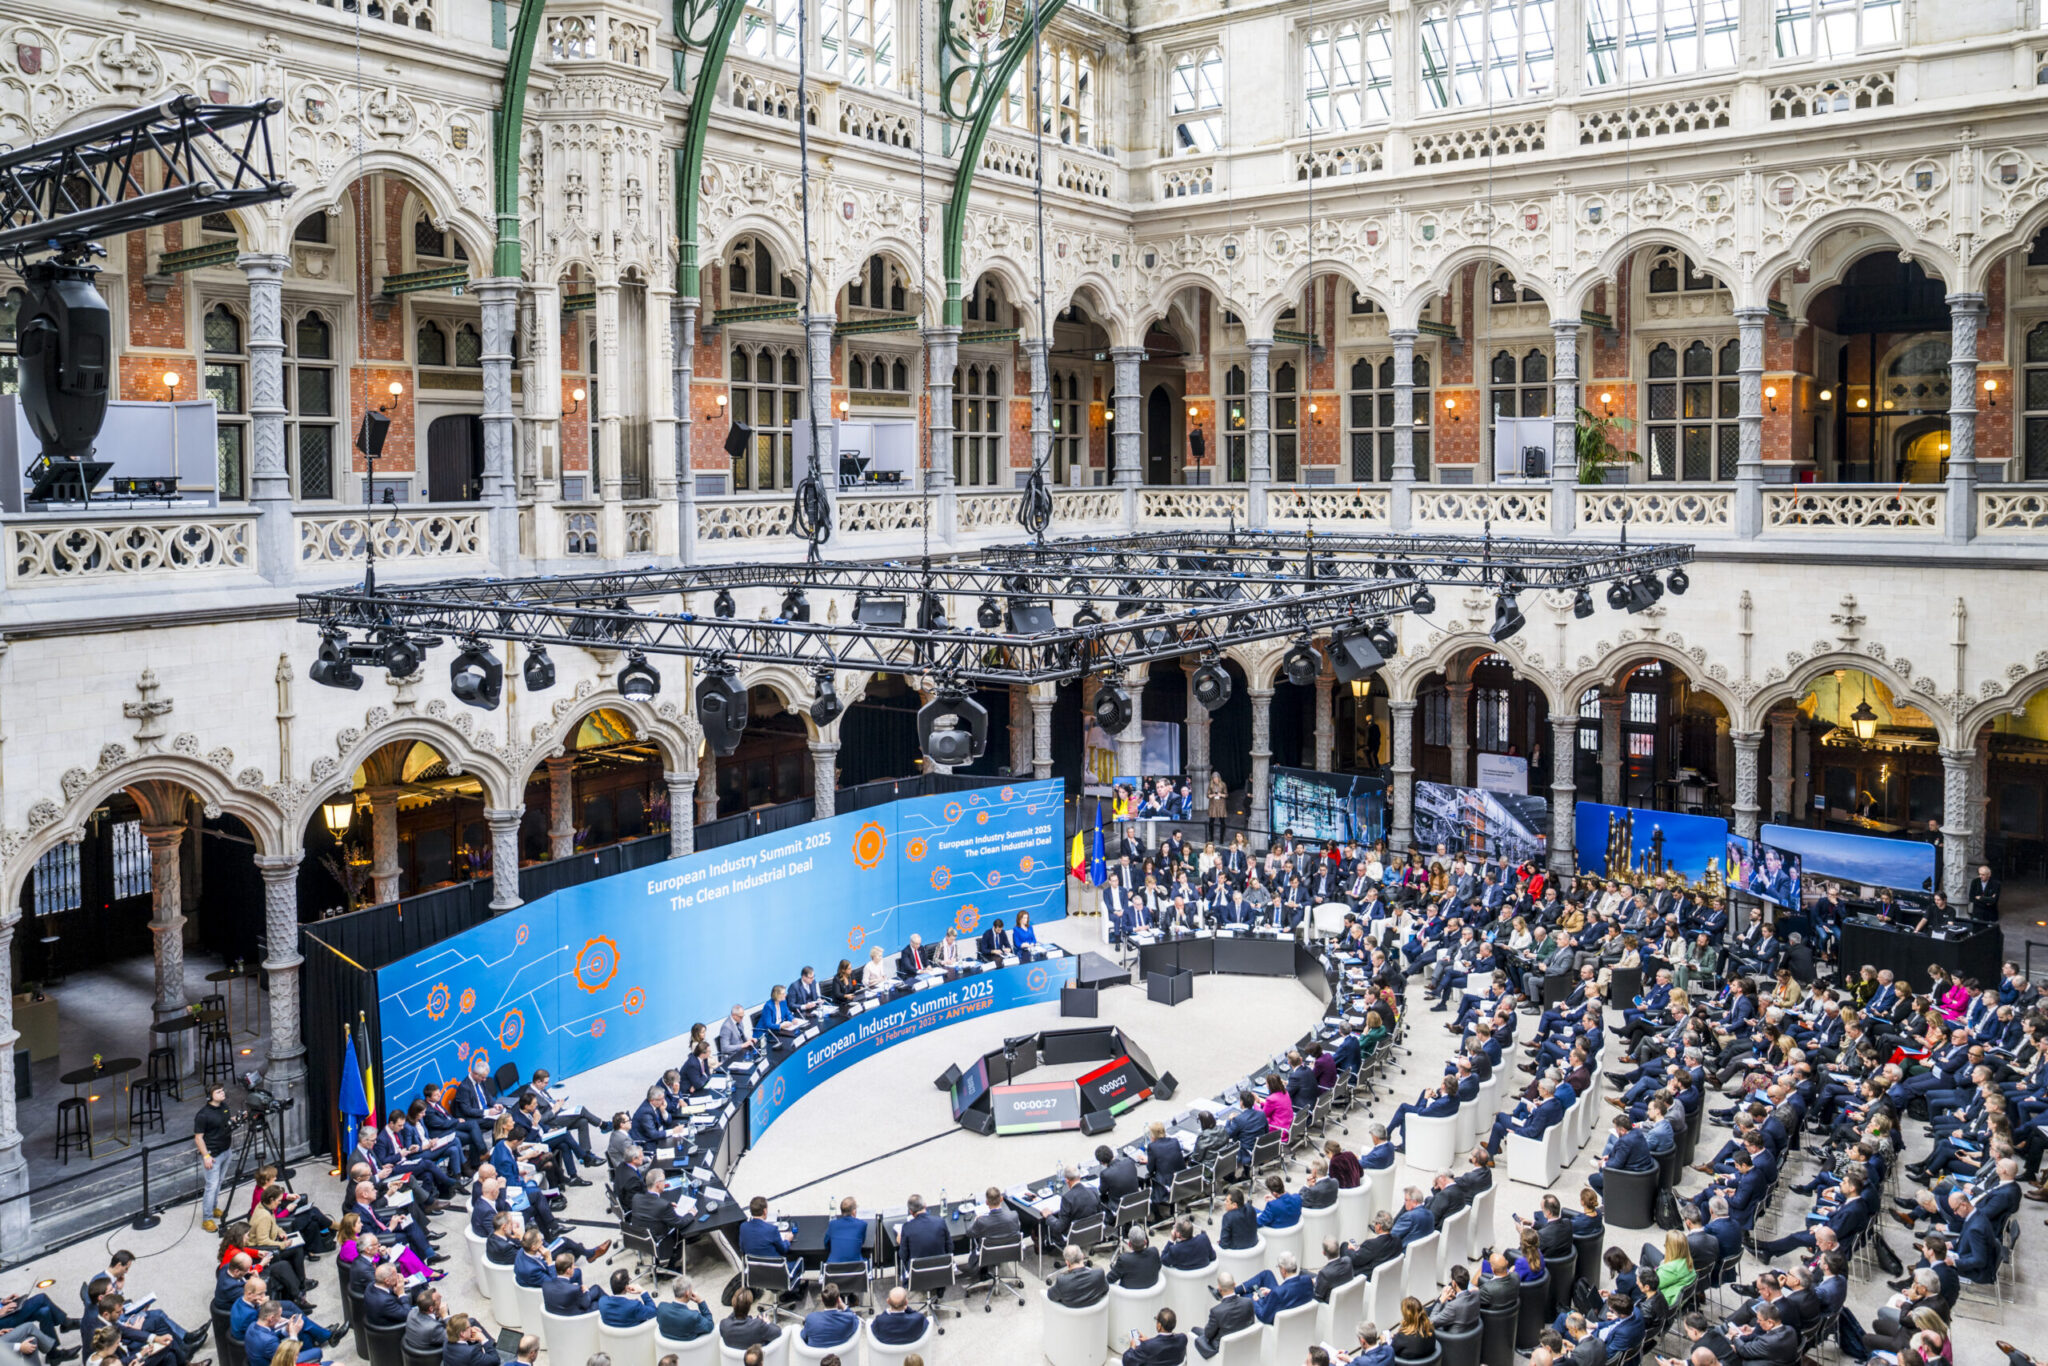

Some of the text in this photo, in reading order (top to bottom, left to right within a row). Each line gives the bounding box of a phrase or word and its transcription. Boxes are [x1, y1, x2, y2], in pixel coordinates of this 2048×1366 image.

[938, 824, 1052, 850] European Industry Summit 2025
[964, 836, 1052, 858] The Clean Industrial Deal
[647, 831, 832, 895] European Industry Summit 2025
[670, 857, 813, 912] The Clean Industrial Deal
[807, 979, 994, 1069] European Industry Summit 2025
[875, 1037, 884, 1046] 26
[885, 1024, 917, 1040] February
[918, 1016, 937, 1029] 2025
[945, 999, 994, 1020] ANTWERP
[1098, 1074, 1128, 1095] 00:00:27
[1013, 1098, 1058, 1111] 00:00:27
